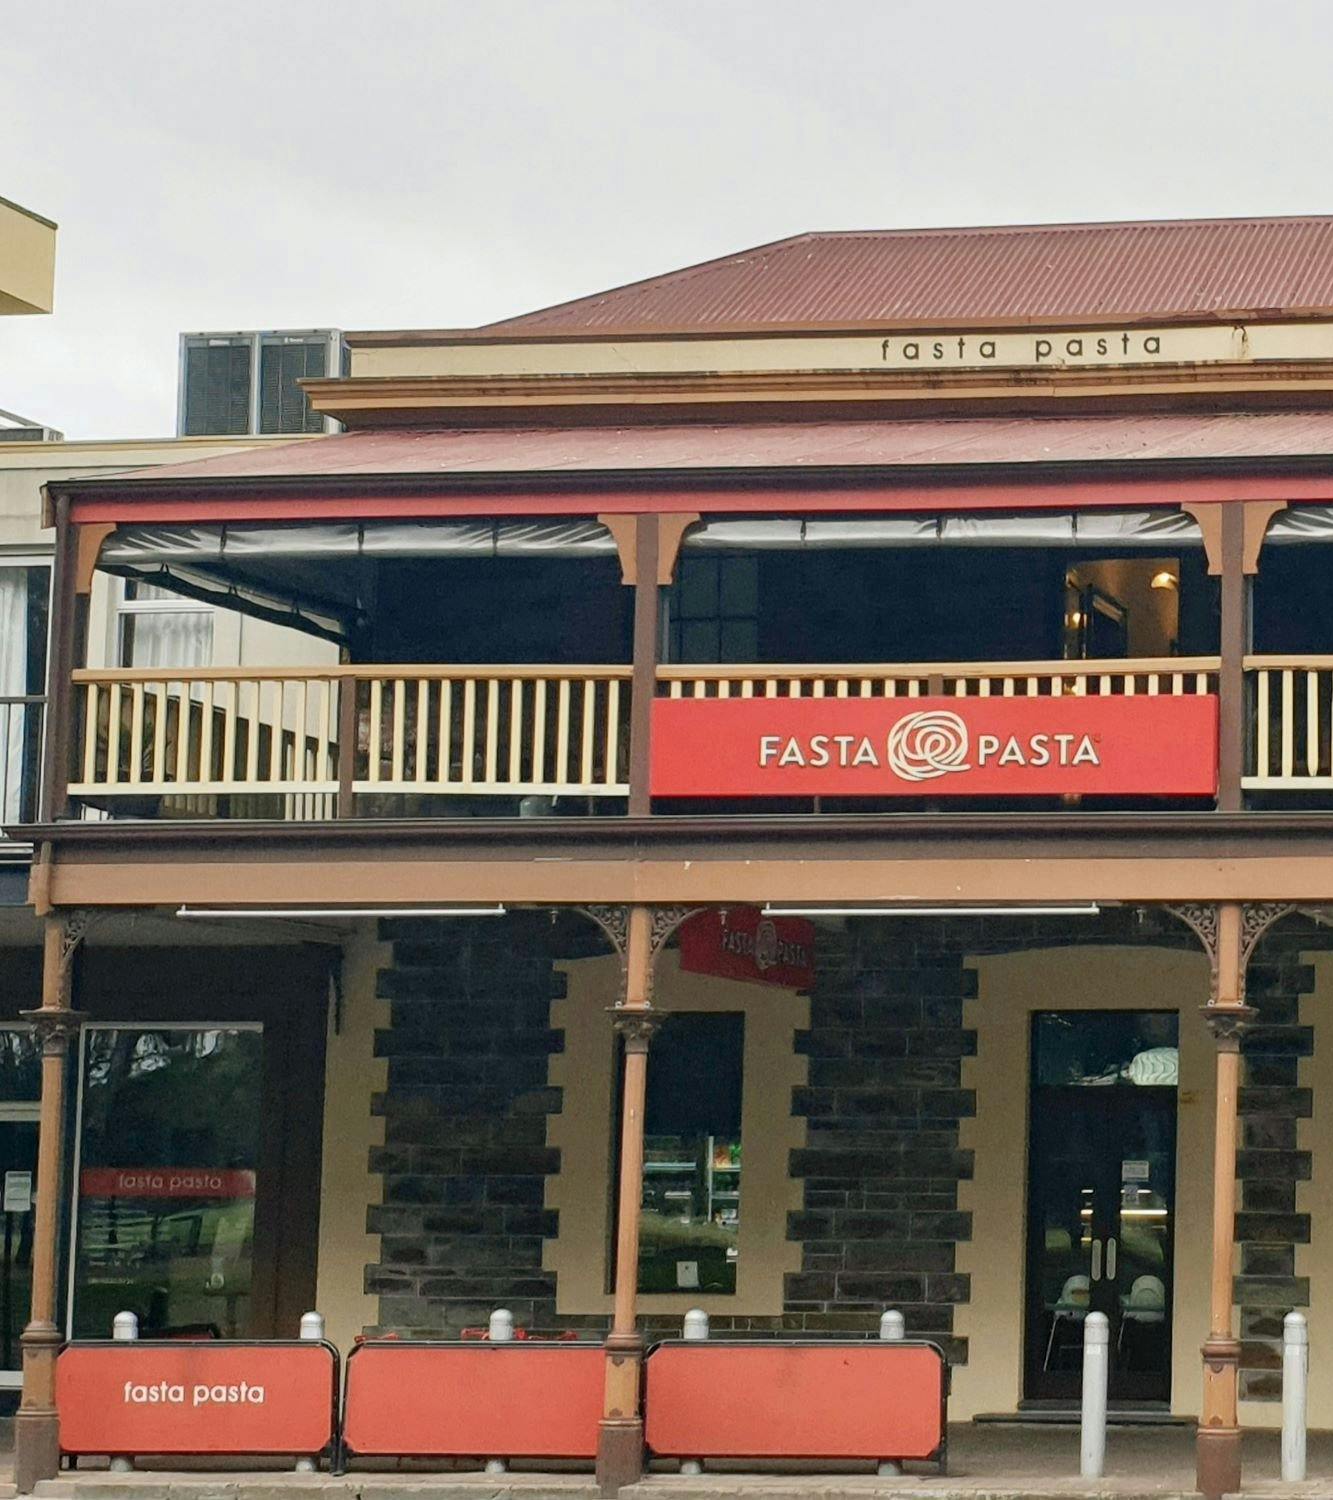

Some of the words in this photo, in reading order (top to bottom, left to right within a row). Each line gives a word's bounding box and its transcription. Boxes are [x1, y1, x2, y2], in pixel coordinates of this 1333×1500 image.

[881, 336, 996, 361] fasta
[1035, 333, 1161, 362] pasta
[758, 735, 879, 768] FASTA
[978, 733, 1100, 767] PASTA
[118, 1173, 163, 1189] fasta
[169, 1173, 221, 1192] pasta
[124, 1380, 184, 1403] fasta
[193, 1381, 265, 1406] pasta
